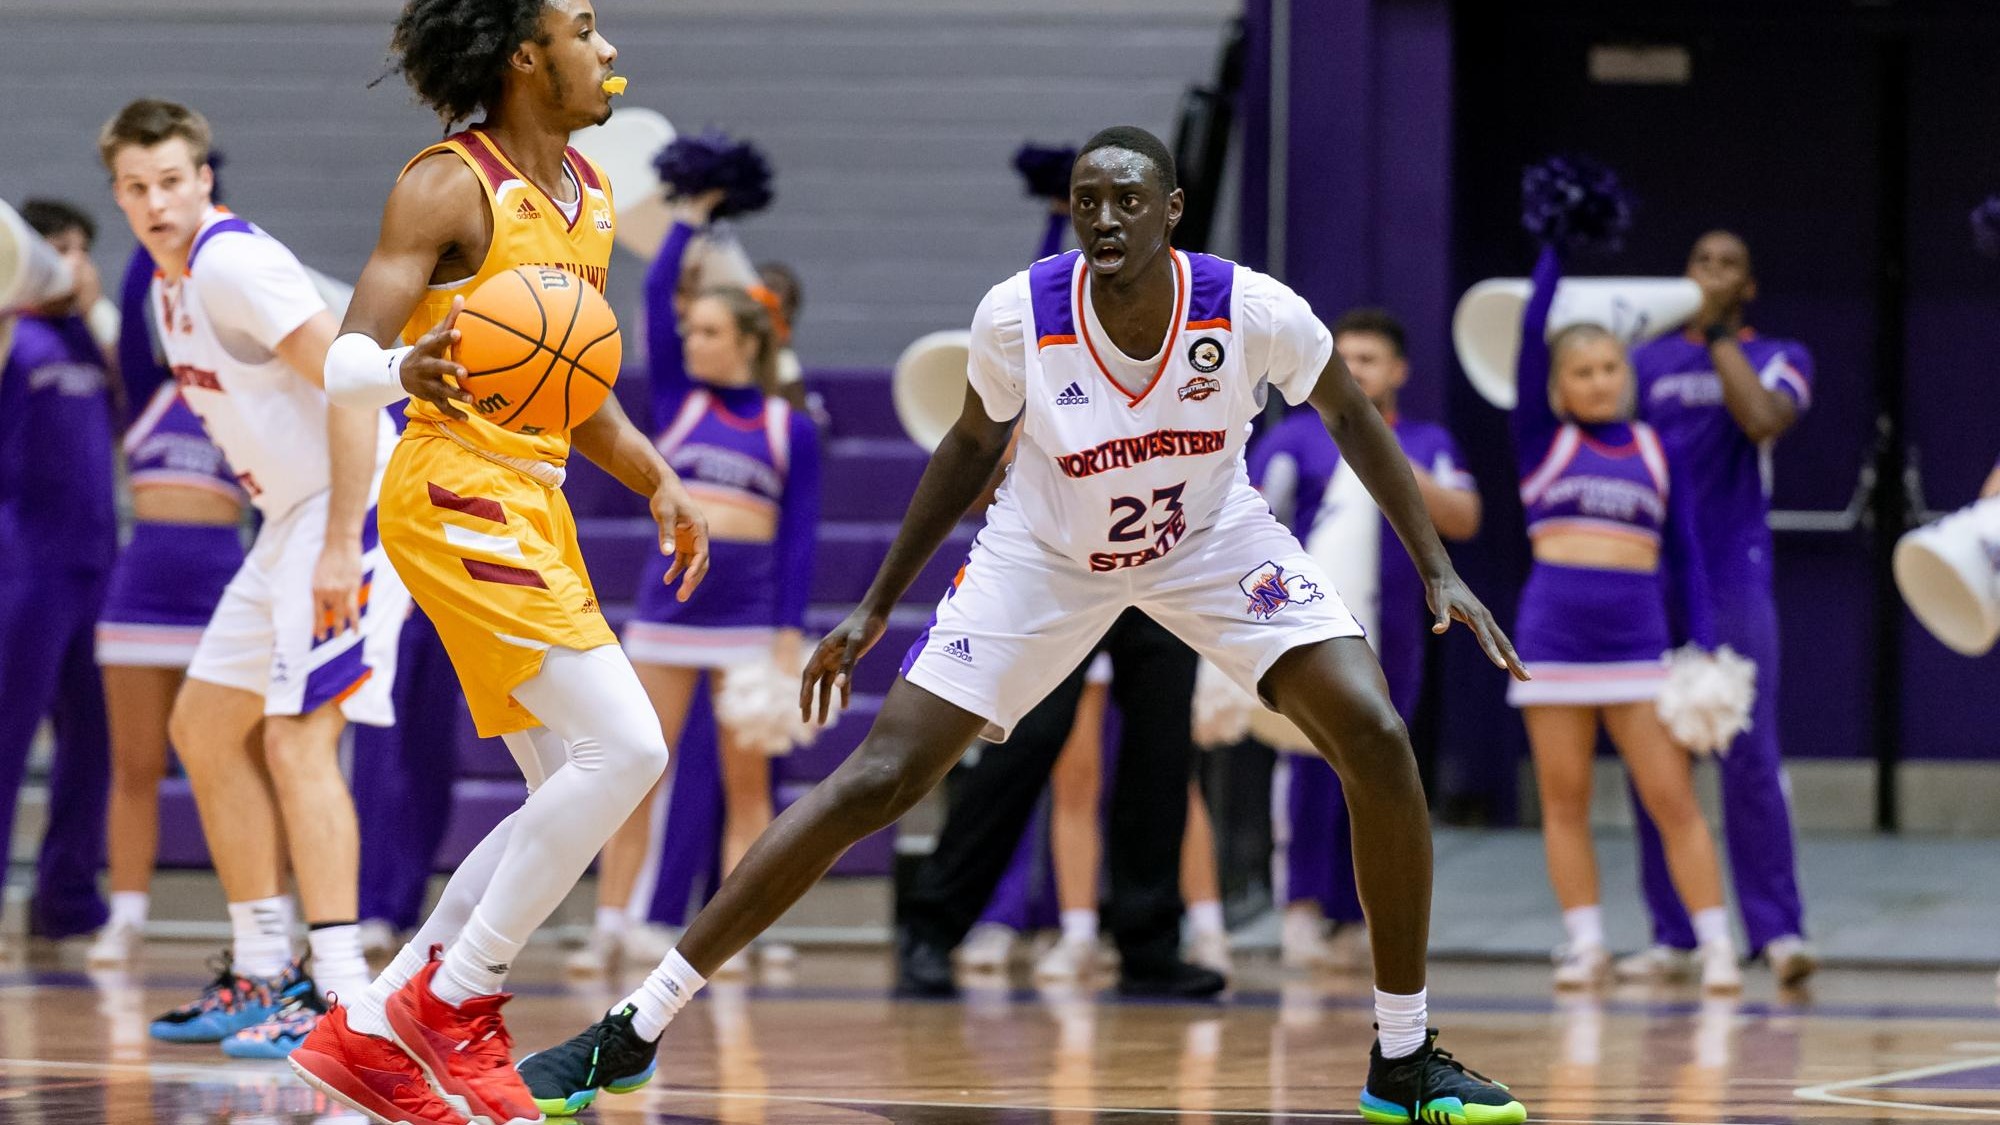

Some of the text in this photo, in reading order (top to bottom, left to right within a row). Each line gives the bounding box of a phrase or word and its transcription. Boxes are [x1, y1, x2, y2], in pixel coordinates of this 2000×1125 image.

[1056, 396, 1089, 405] adidas
[1055, 428, 1227, 478] NORTHWESTERN
[1108, 480, 1187, 542] 23
[1089, 510, 1187, 573] STATE
[943, 645, 973, 663] adidas
